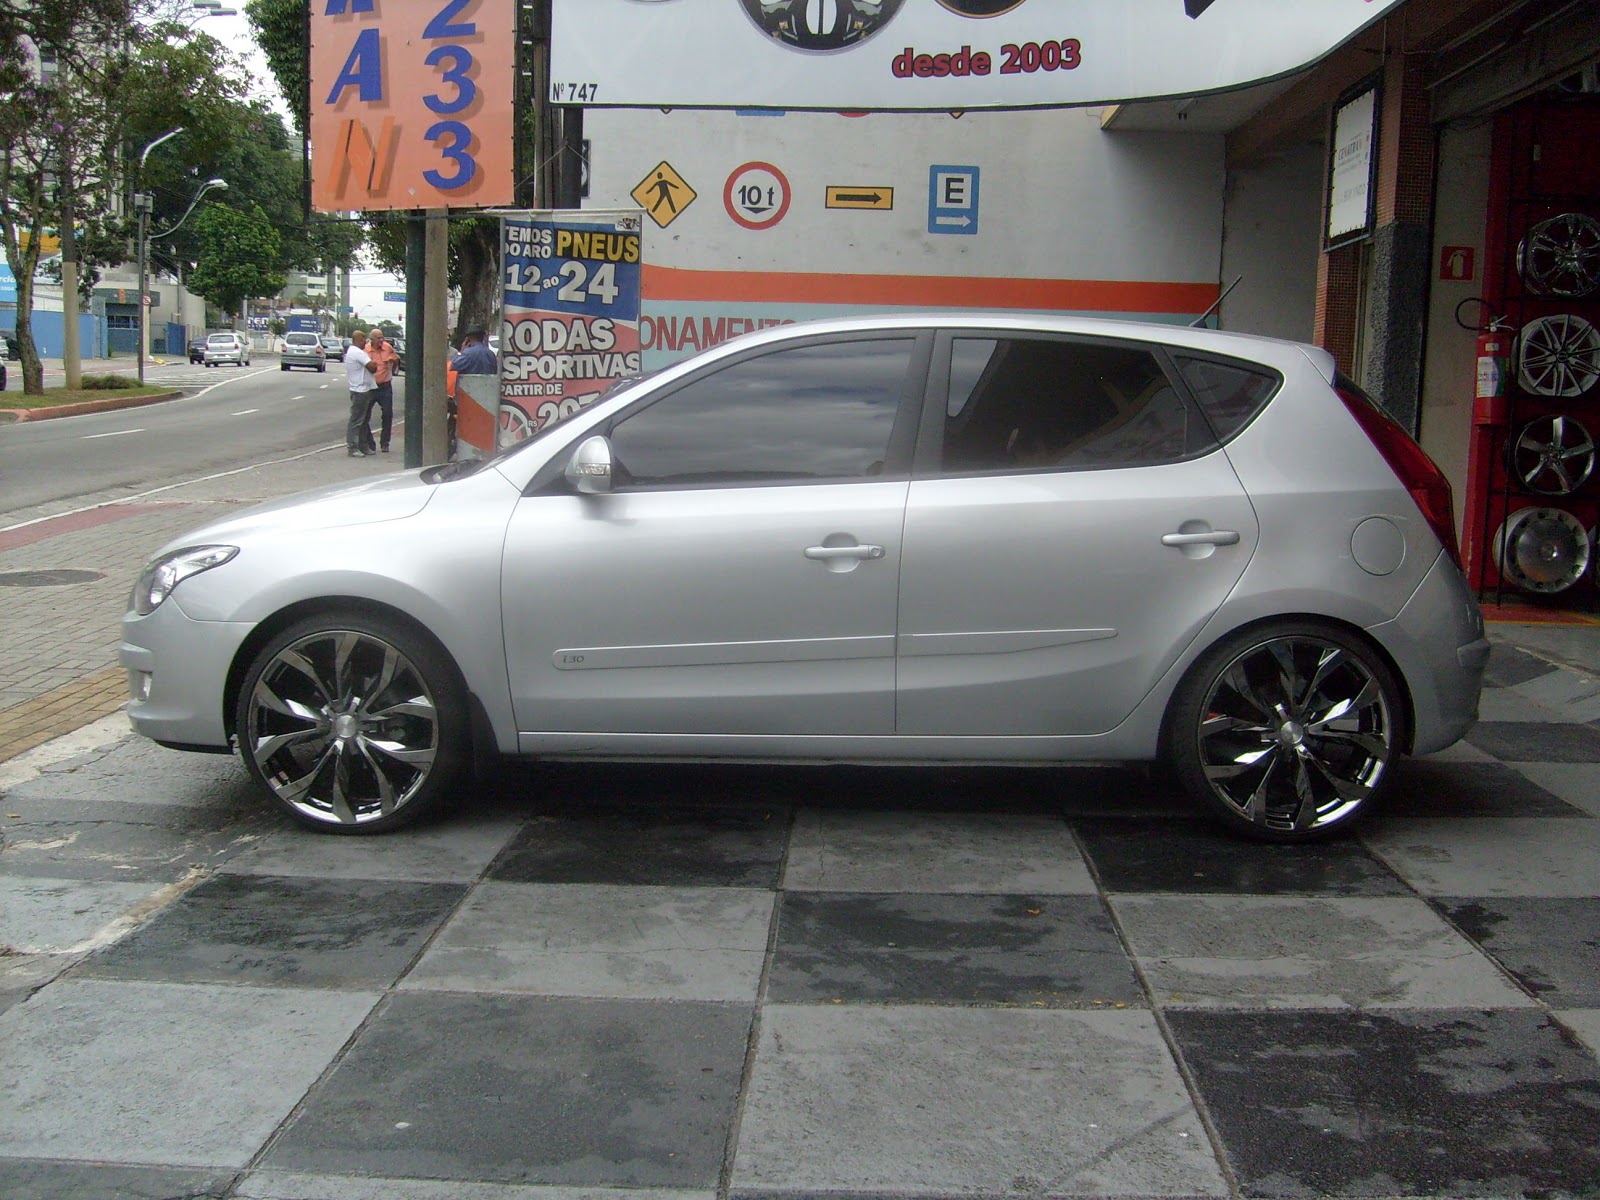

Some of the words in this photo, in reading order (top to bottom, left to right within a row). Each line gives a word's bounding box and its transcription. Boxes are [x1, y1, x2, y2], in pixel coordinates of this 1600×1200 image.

[892, 46, 991, 78] desde
[1000, 38, 1081, 74] 2003
[569, 83, 598, 101] 747
[738, 185, 762, 206] 10
[945, 178, 965, 204] E
[522, 244, 552, 259] ARO
[557, 230, 639, 263] PNEUS
[505, 263, 541, 293] 12
[543, 276, 560, 289] ao
[558, 260, 619, 304] 24
[640, 316, 797, 351] ONAME
[546, 383, 563, 395] DE
